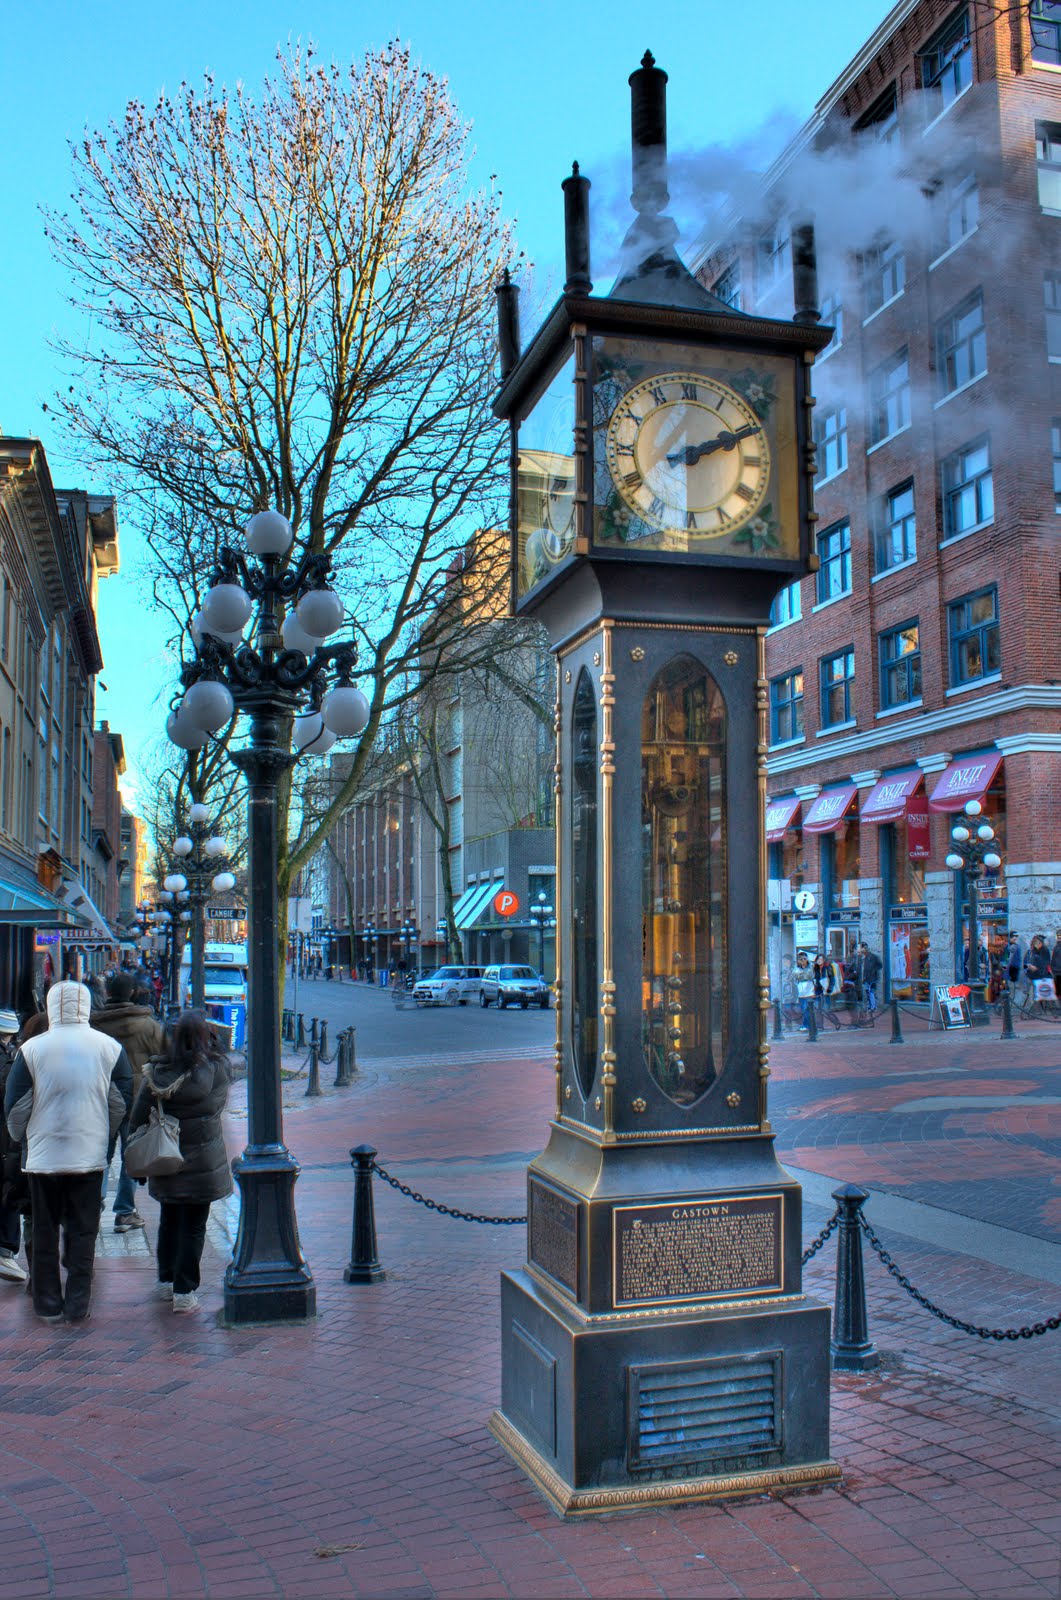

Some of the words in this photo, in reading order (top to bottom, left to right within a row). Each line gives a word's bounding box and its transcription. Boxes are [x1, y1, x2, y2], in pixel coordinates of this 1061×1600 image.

[950, 765, 986, 783] INUIT
[878, 781, 909, 798] INUIT
[501, 896, 513, 912] P
[210, 909, 234, 918] CAMBIE
[66, 928, 104, 937] HILL'S
[230, 1007, 239, 1020] The
[672, 1206, 729, 1219] GASTOWN
